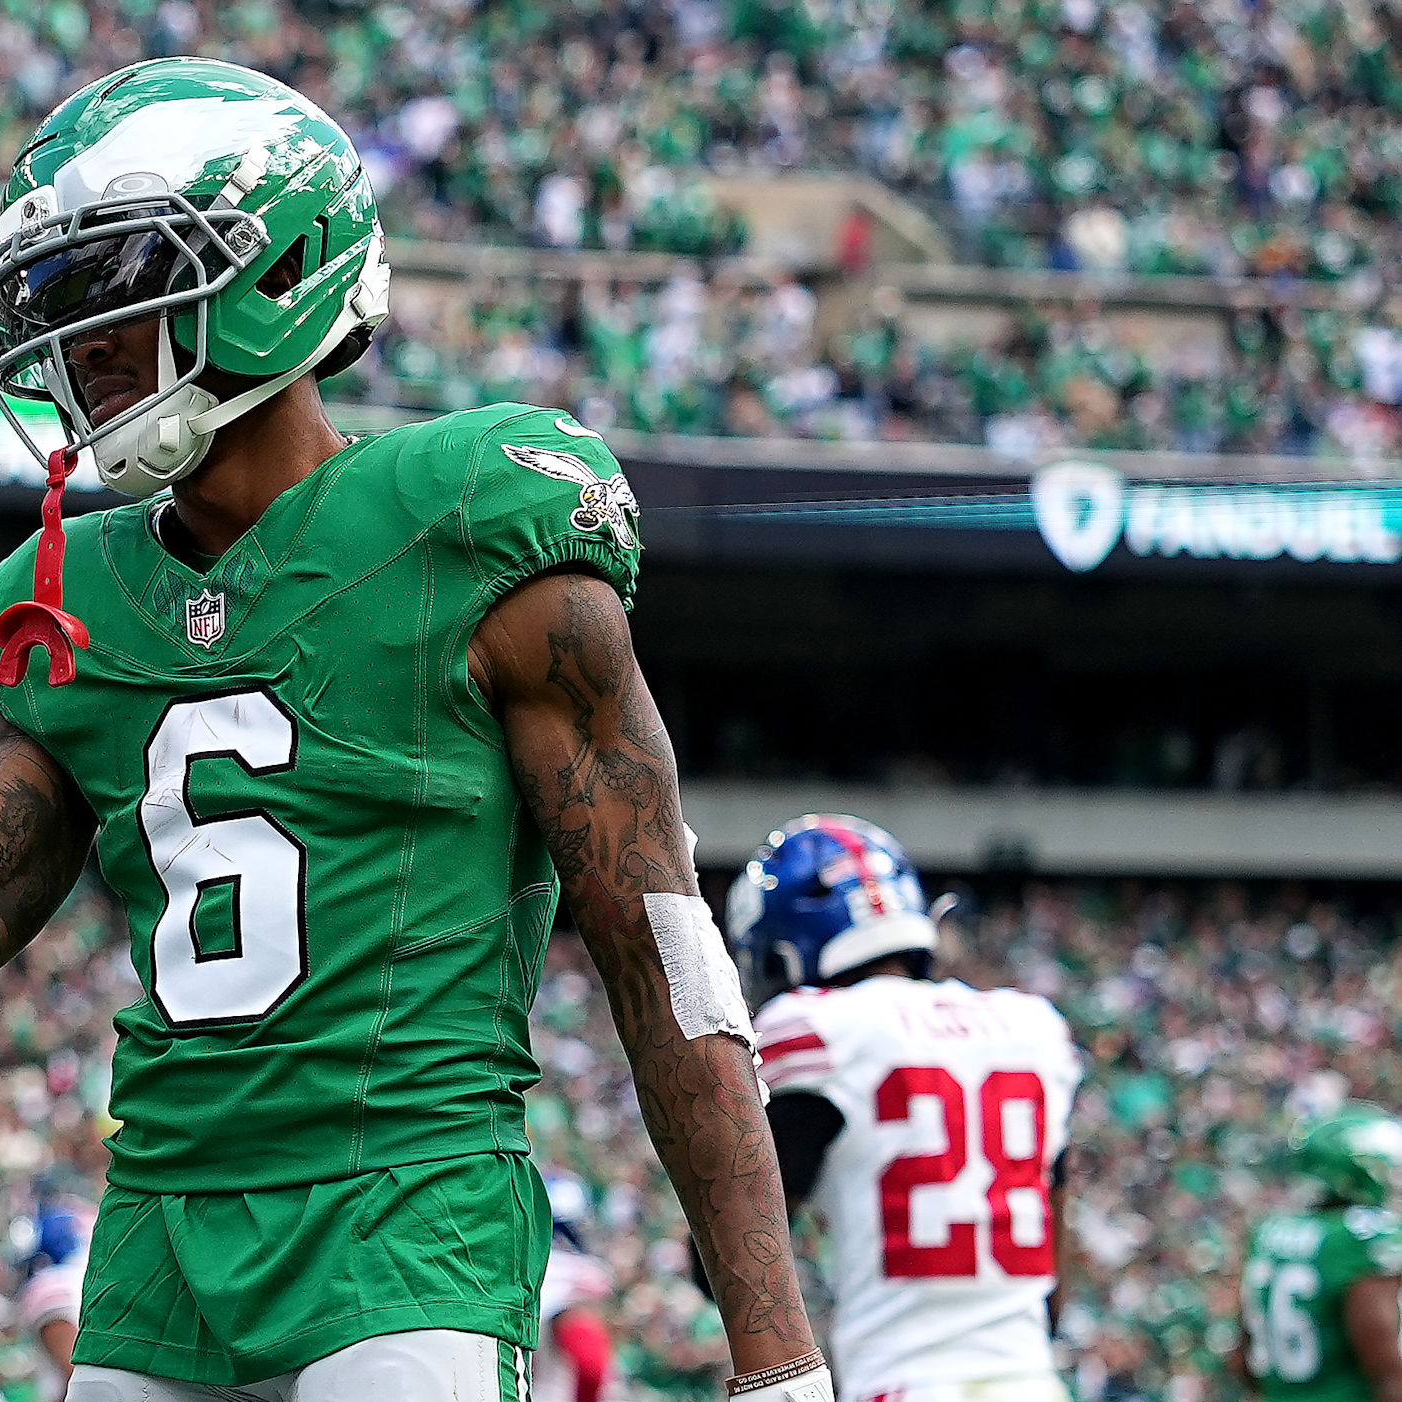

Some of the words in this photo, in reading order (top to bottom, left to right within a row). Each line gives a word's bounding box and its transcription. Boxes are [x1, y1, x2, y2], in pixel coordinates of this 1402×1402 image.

[193, 614, 220, 638] NFL
[136, 683, 309, 1030] 6
[875, 1066, 1056, 1278] 28
